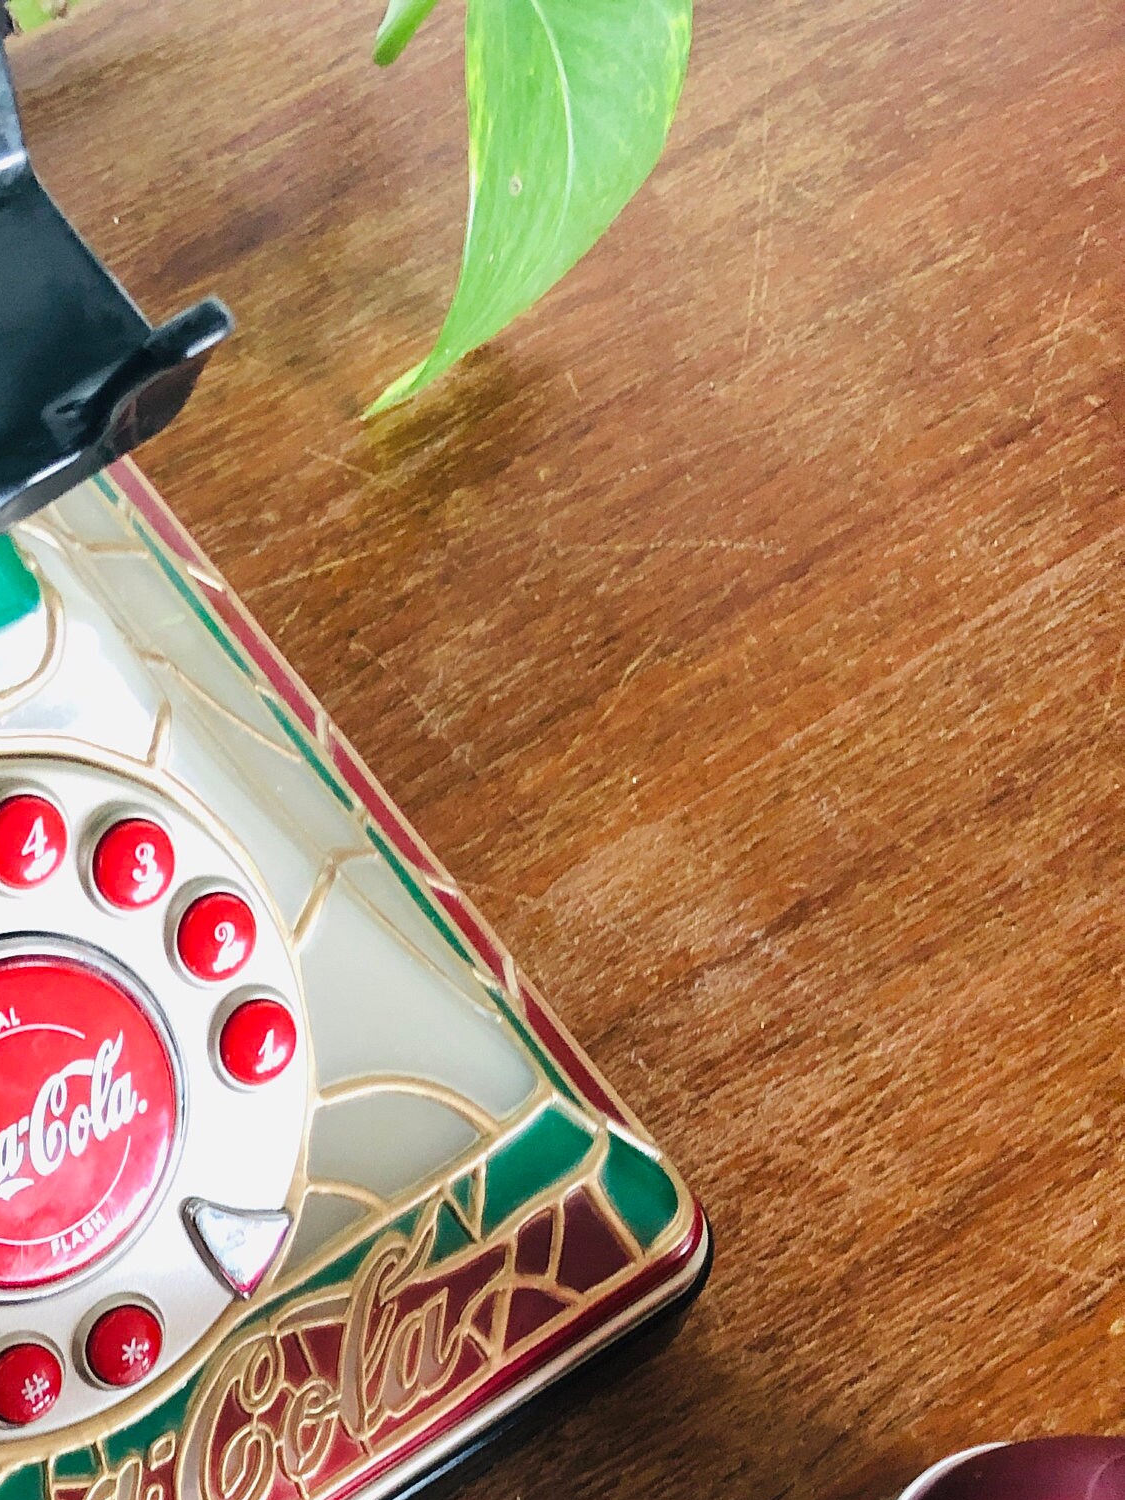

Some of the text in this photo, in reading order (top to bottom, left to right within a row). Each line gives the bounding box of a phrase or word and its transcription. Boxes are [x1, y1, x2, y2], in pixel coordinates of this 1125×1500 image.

[21, 816, 48, 859] 4
[132, 843, 158, 882] 3
[213, 921, 240, 962] 2
[256, 1028, 277, 1073] 1
[50, 1212, 108, 1257] FLASH
